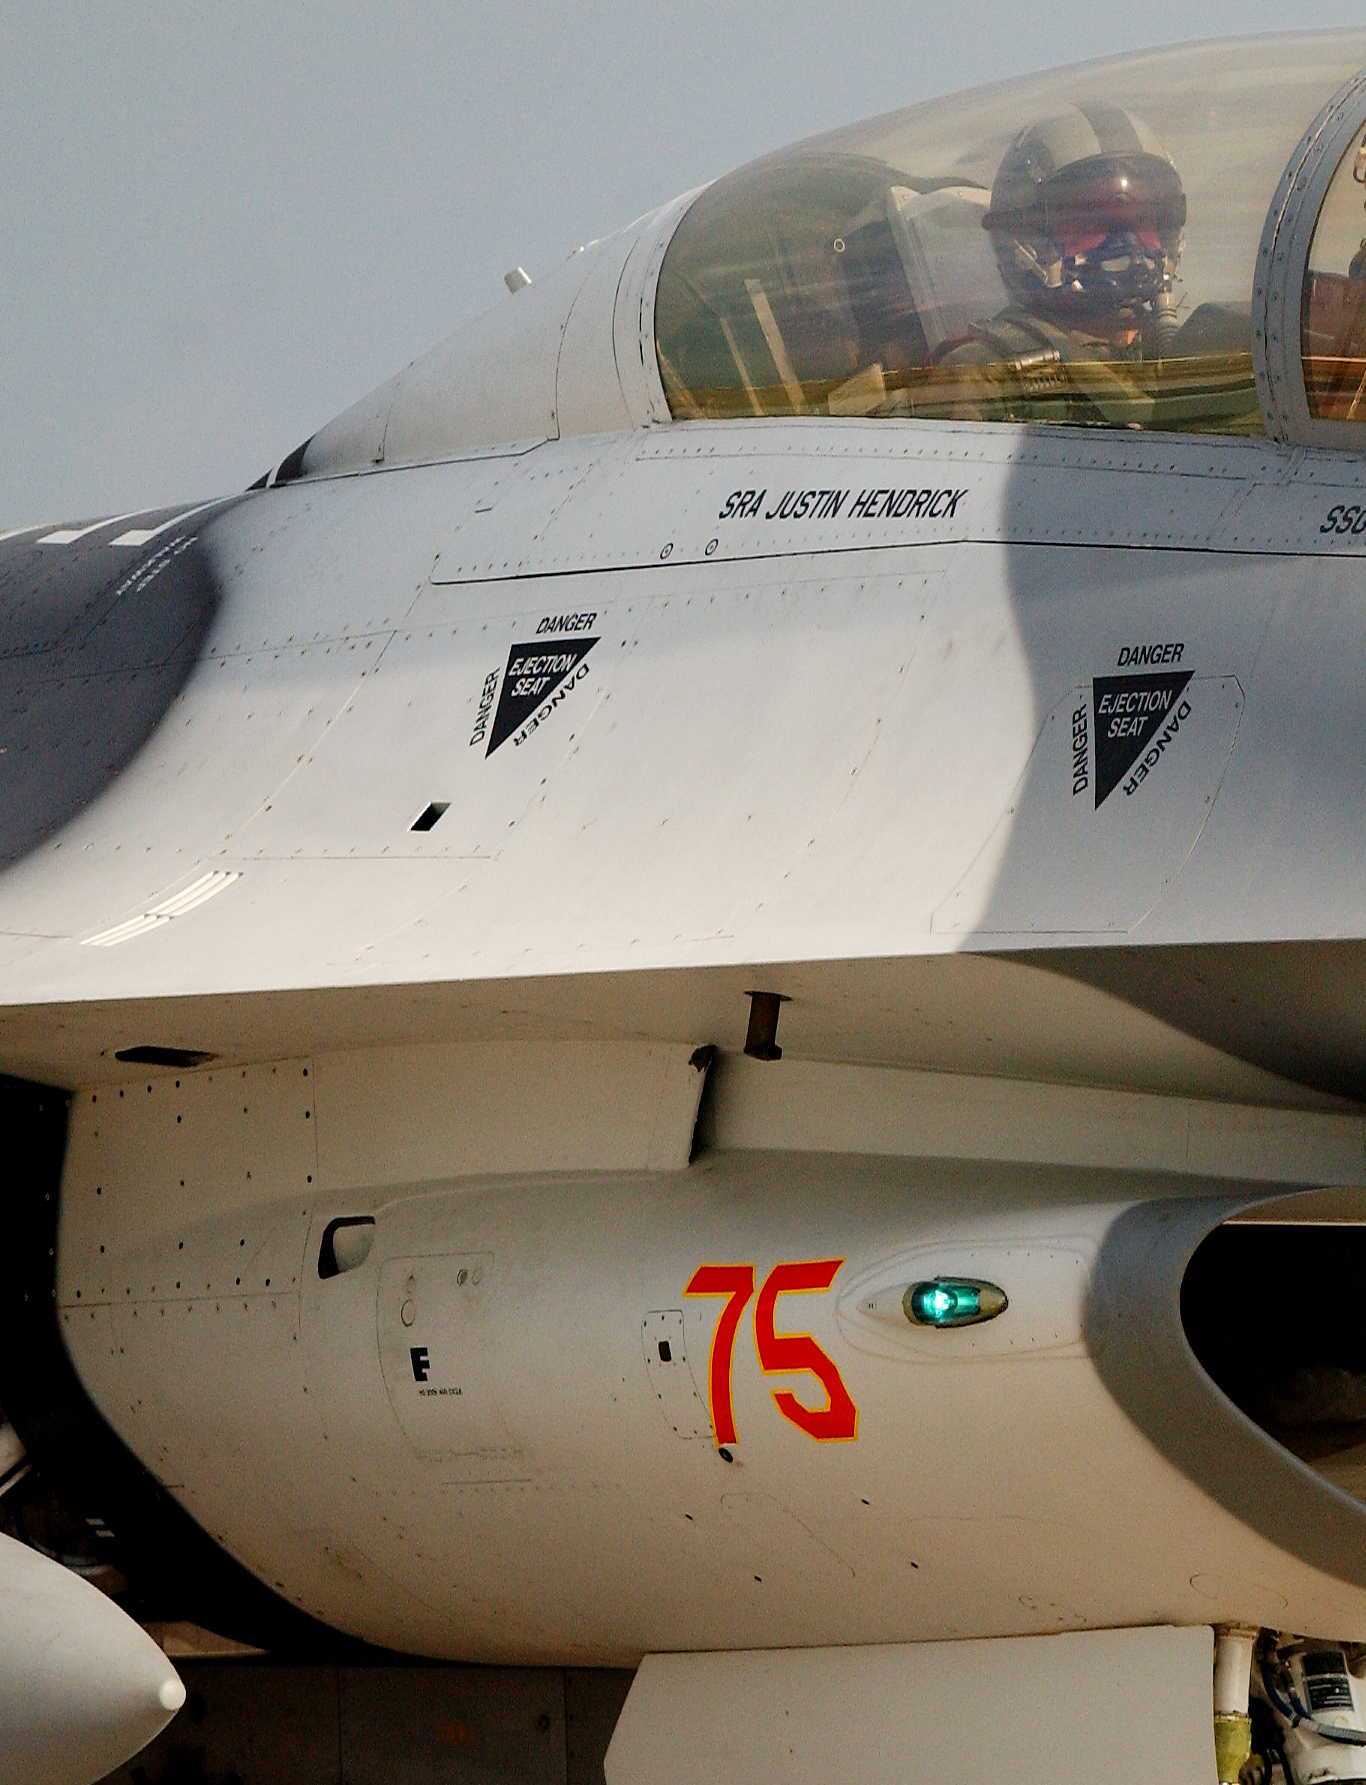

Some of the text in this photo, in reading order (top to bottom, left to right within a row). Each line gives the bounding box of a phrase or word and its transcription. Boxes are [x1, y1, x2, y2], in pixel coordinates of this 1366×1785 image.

[719, 489, 968, 519] SRA JUSTIN HENDRICK
[536, 612, 597, 634] DANGER
[508, 653, 577, 676] EJECTION
[1117, 643, 1184, 666] DANGER
[511, 677, 550, 697] SEAT
[469, 667, 500, 746] DANGER
[513, 663, 590, 746] DANGER
[1098, 690, 1173, 714] EJECTION
[1107, 716, 1148, 738] SEAT
[1073, 703, 1088, 796] DANGER
[1123, 700, 1192, 795] DANGER
[683, 1257, 858, 1447] 75
